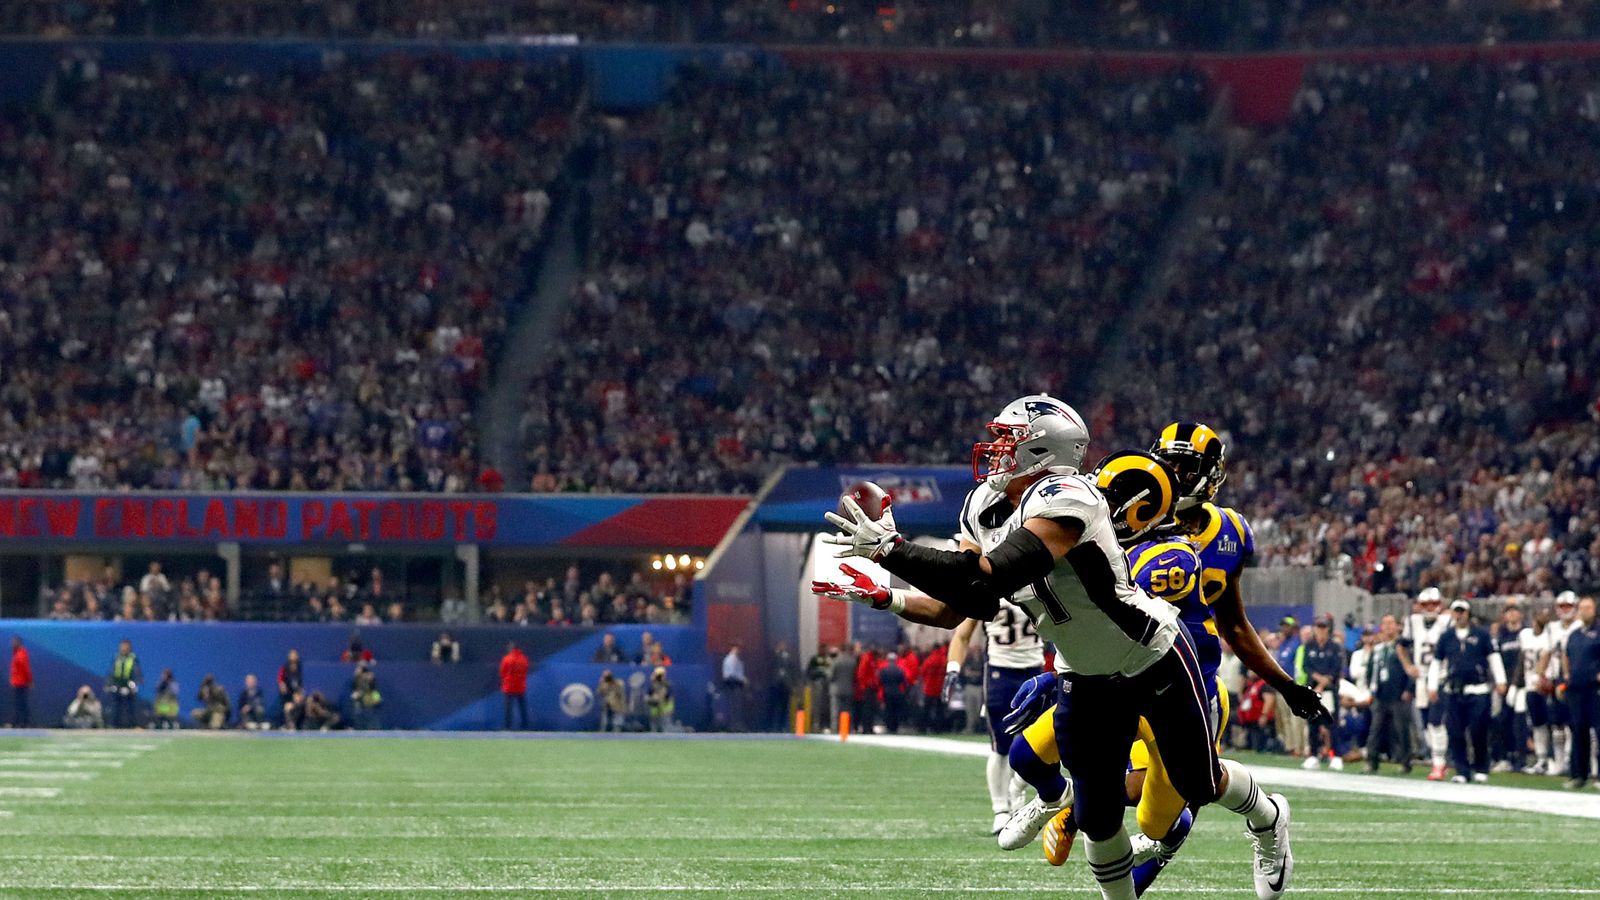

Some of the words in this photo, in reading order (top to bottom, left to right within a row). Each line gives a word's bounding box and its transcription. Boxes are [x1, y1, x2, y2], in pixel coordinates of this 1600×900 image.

[95, 498, 288, 539] ENGLAND
[302, 500, 498, 541] PATRIOTS
[1151, 566, 1185, 592] 58
